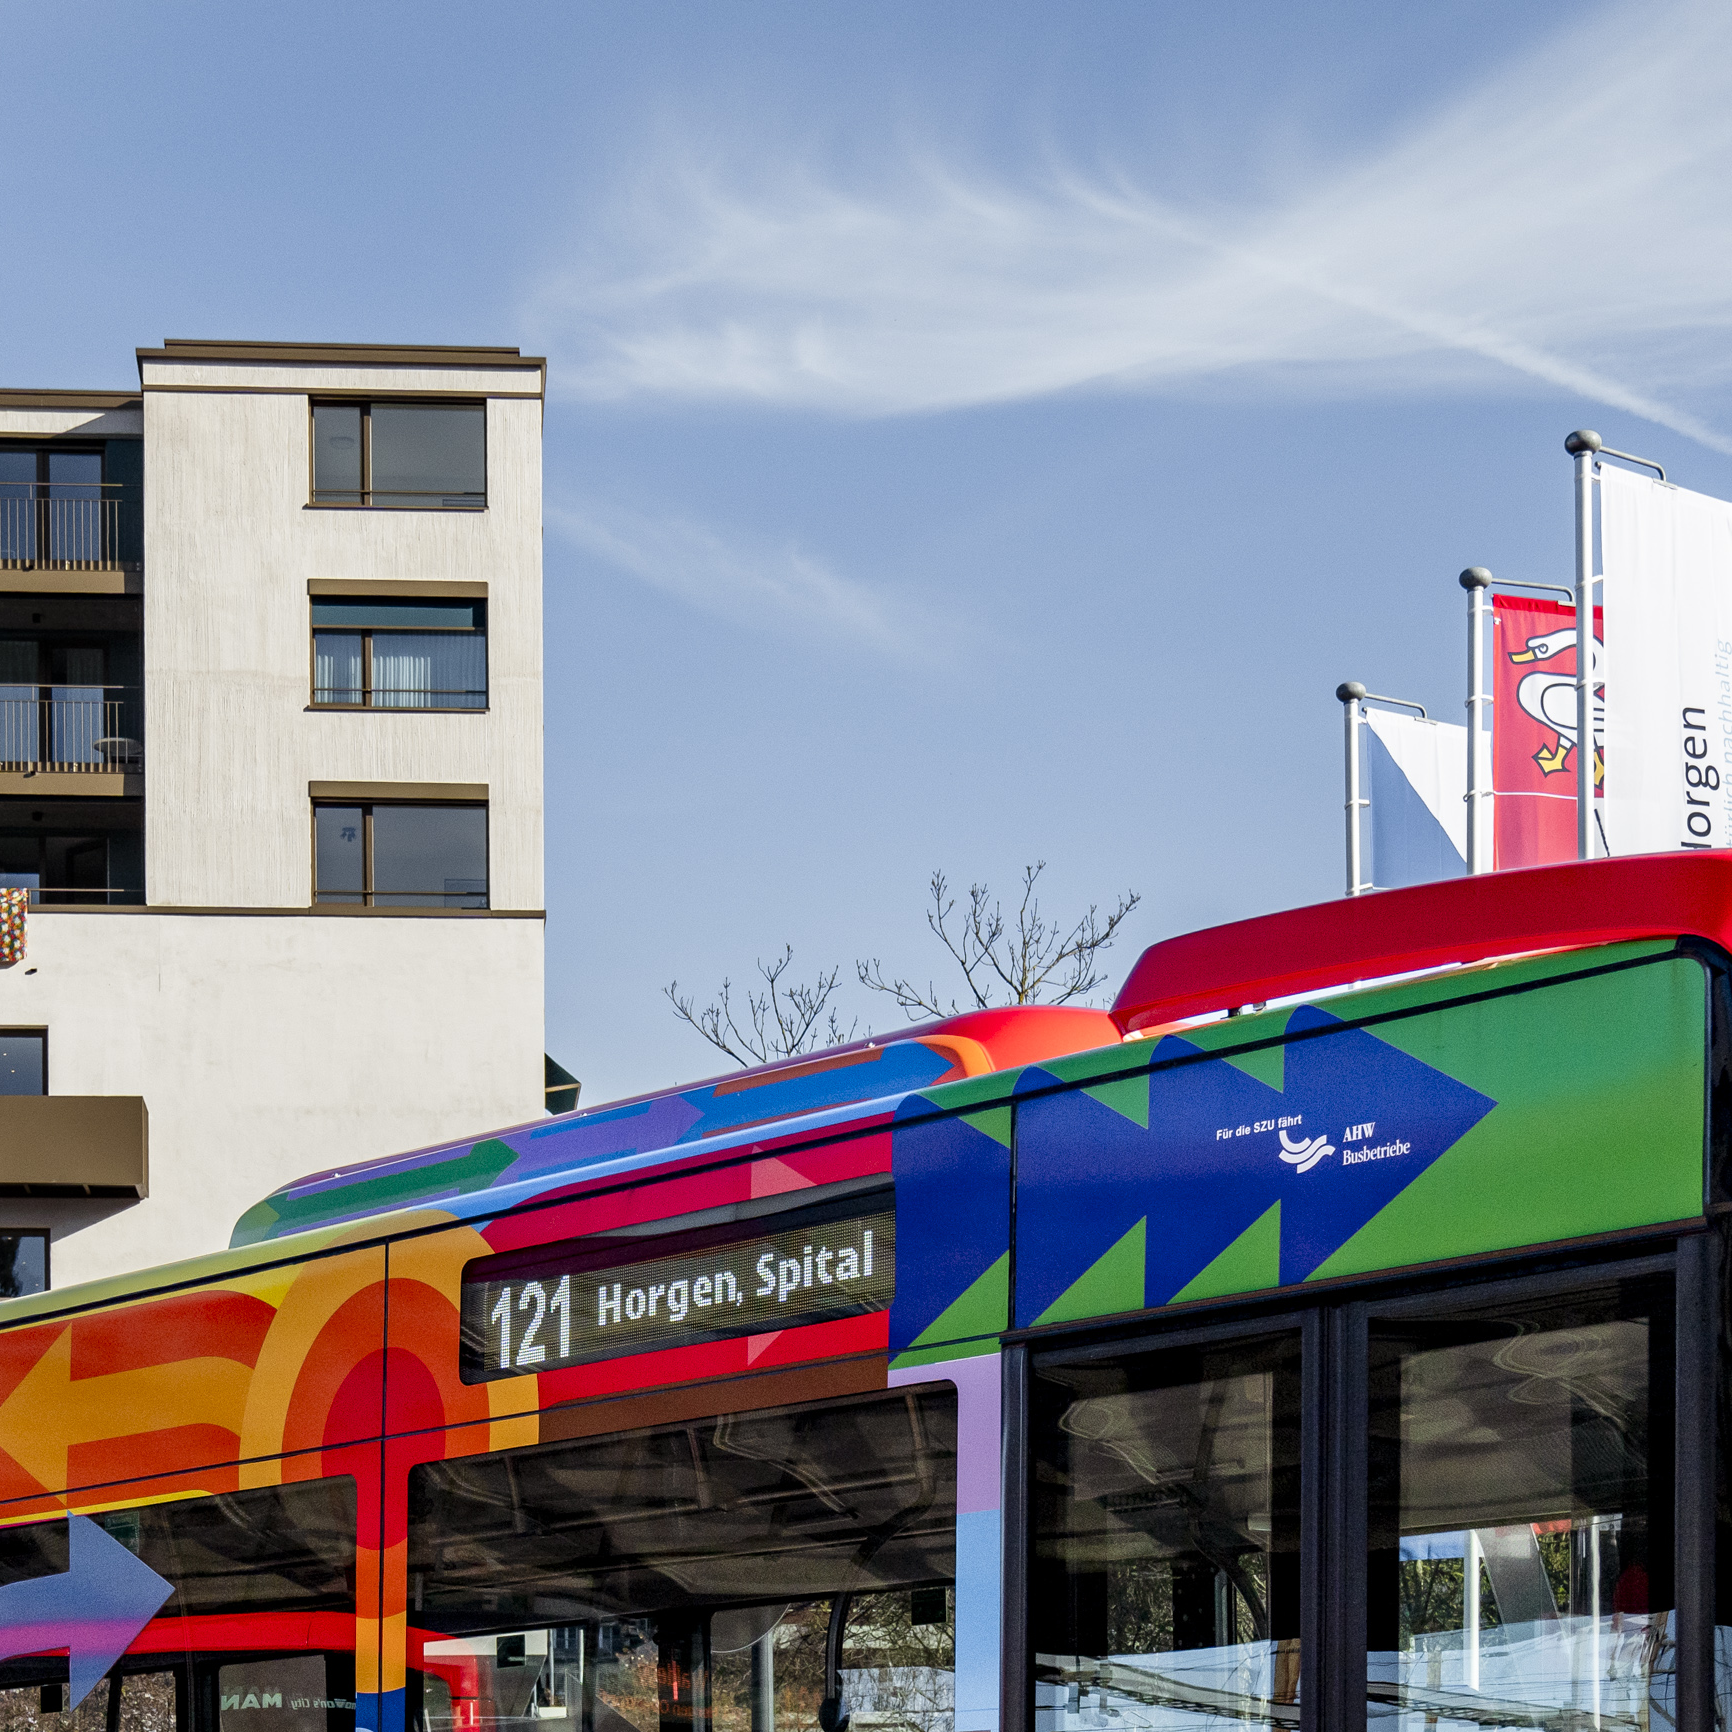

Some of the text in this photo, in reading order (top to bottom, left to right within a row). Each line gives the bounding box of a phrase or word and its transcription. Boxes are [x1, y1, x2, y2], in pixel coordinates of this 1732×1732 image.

[1216, 1114, 1303, 1141] Für die SZU fährt
[1343, 1121, 1376, 1143] AHW
[1342, 1139, 1411, 1166] Busbetriebe
[490, 1229, 874, 1370] 121 Horgen, Spital
